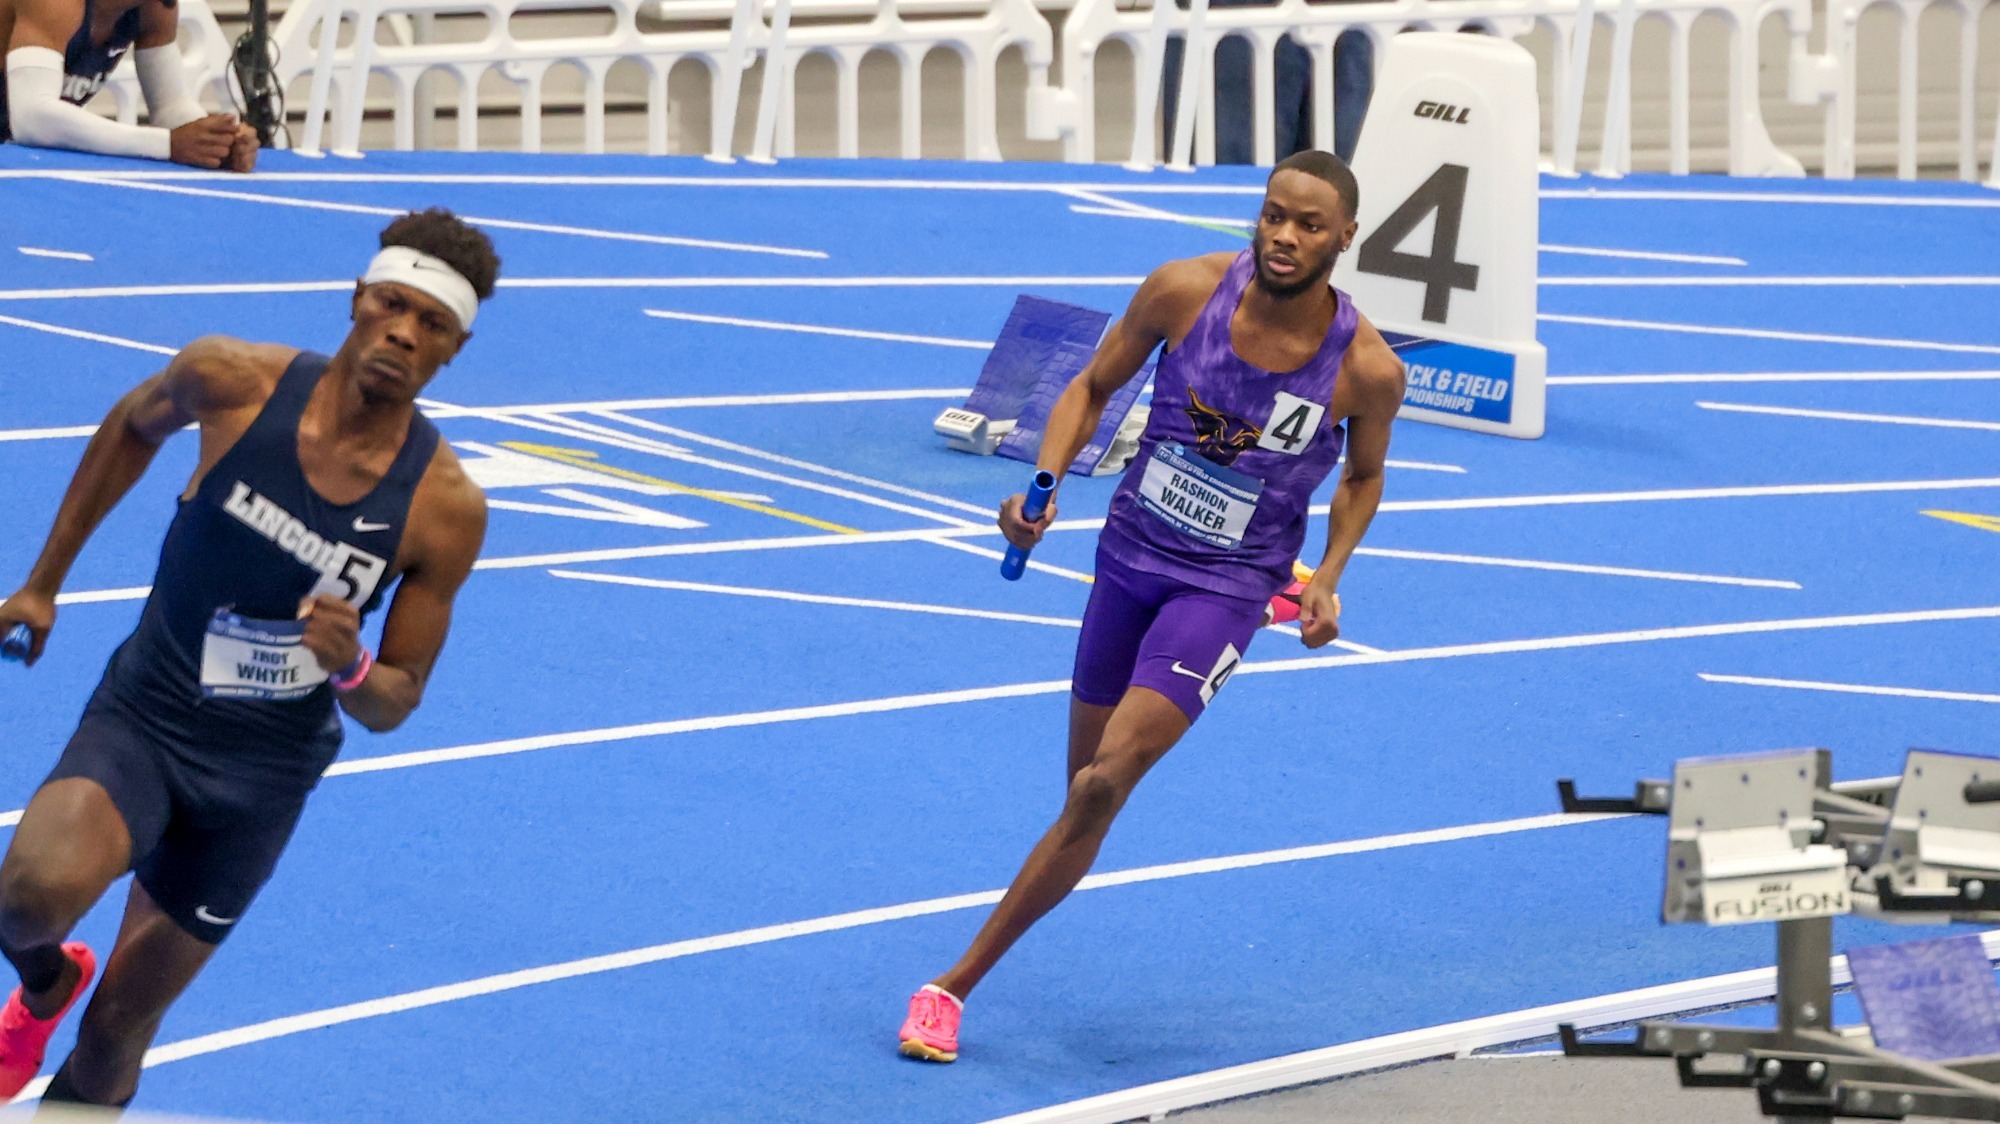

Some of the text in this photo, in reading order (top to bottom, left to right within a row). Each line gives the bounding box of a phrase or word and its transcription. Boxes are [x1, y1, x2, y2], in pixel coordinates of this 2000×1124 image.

[1413, 100, 1471, 125] GILL
[1357, 163, 1480, 324] 4
[1435, 368, 1453, 391] &
[1453, 371, 1509, 402] FIELD
[1271, 404, 1312, 450] 4
[1160, 486, 1226, 530] WALKER
[1170, 473, 1229, 513] RASHION
[337, 553, 374, 600] 5
[236, 661, 302, 685] WHYTE
[1714, 892, 1844, 919] FUSION
